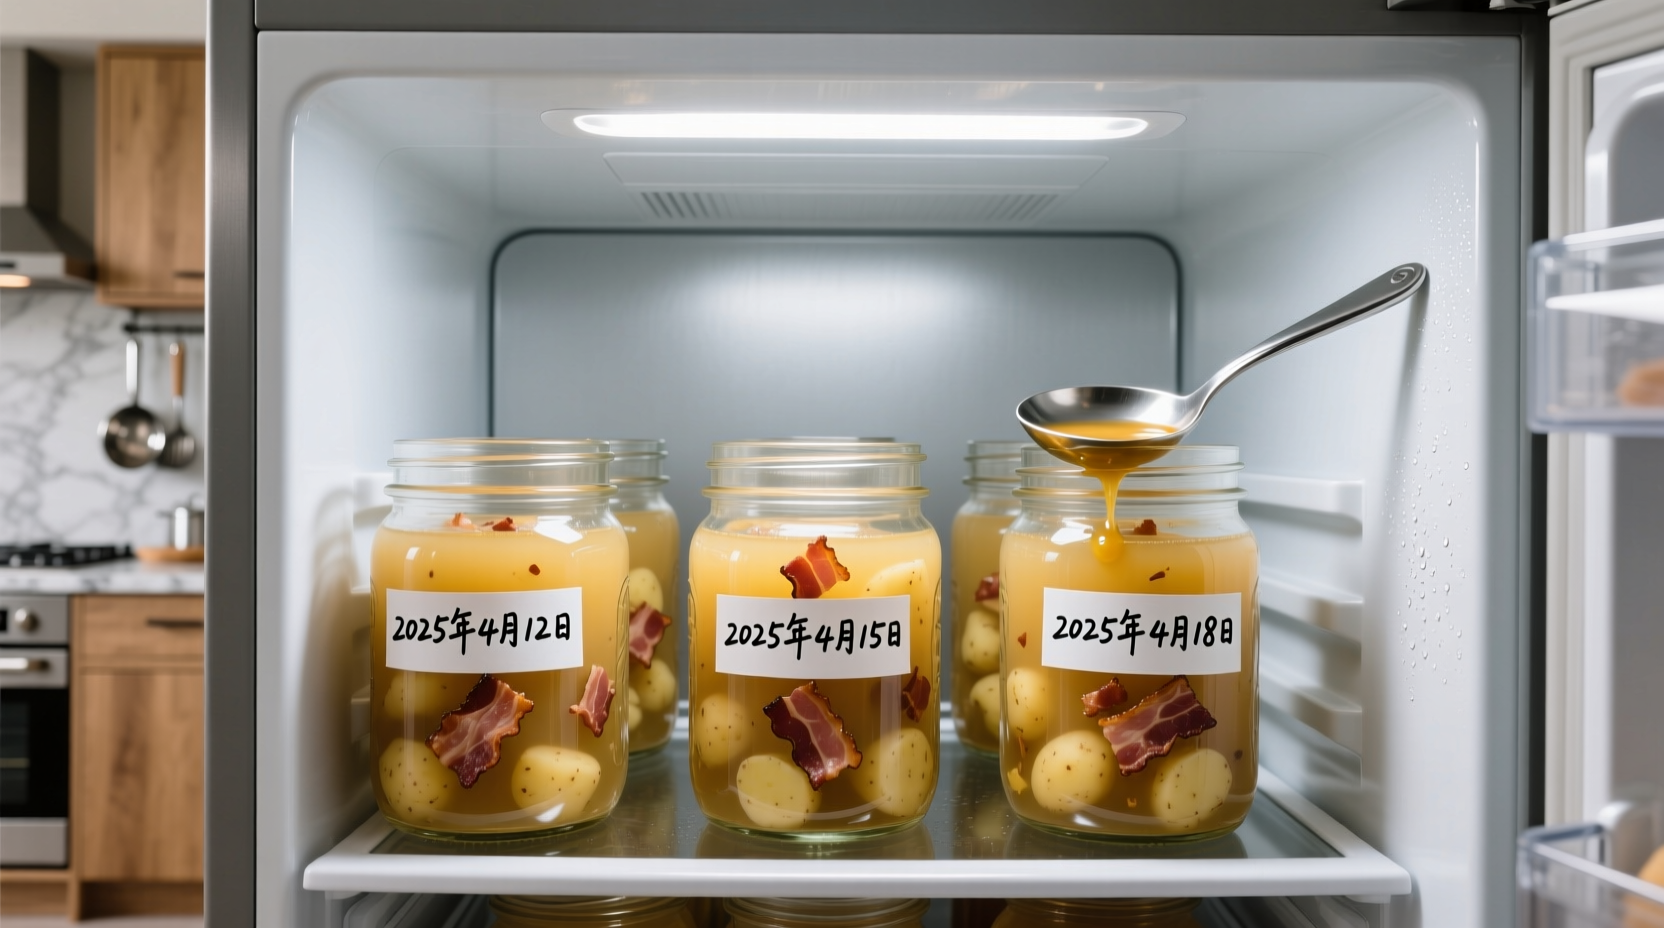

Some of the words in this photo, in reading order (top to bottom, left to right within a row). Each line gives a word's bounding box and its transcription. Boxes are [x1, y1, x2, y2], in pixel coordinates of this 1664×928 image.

[392, 607, 571, 656] 2025年4月12日
[724, 612, 901, 661] 2025年4月15日
[1052, 608, 1233, 657] 2025年4月18日
